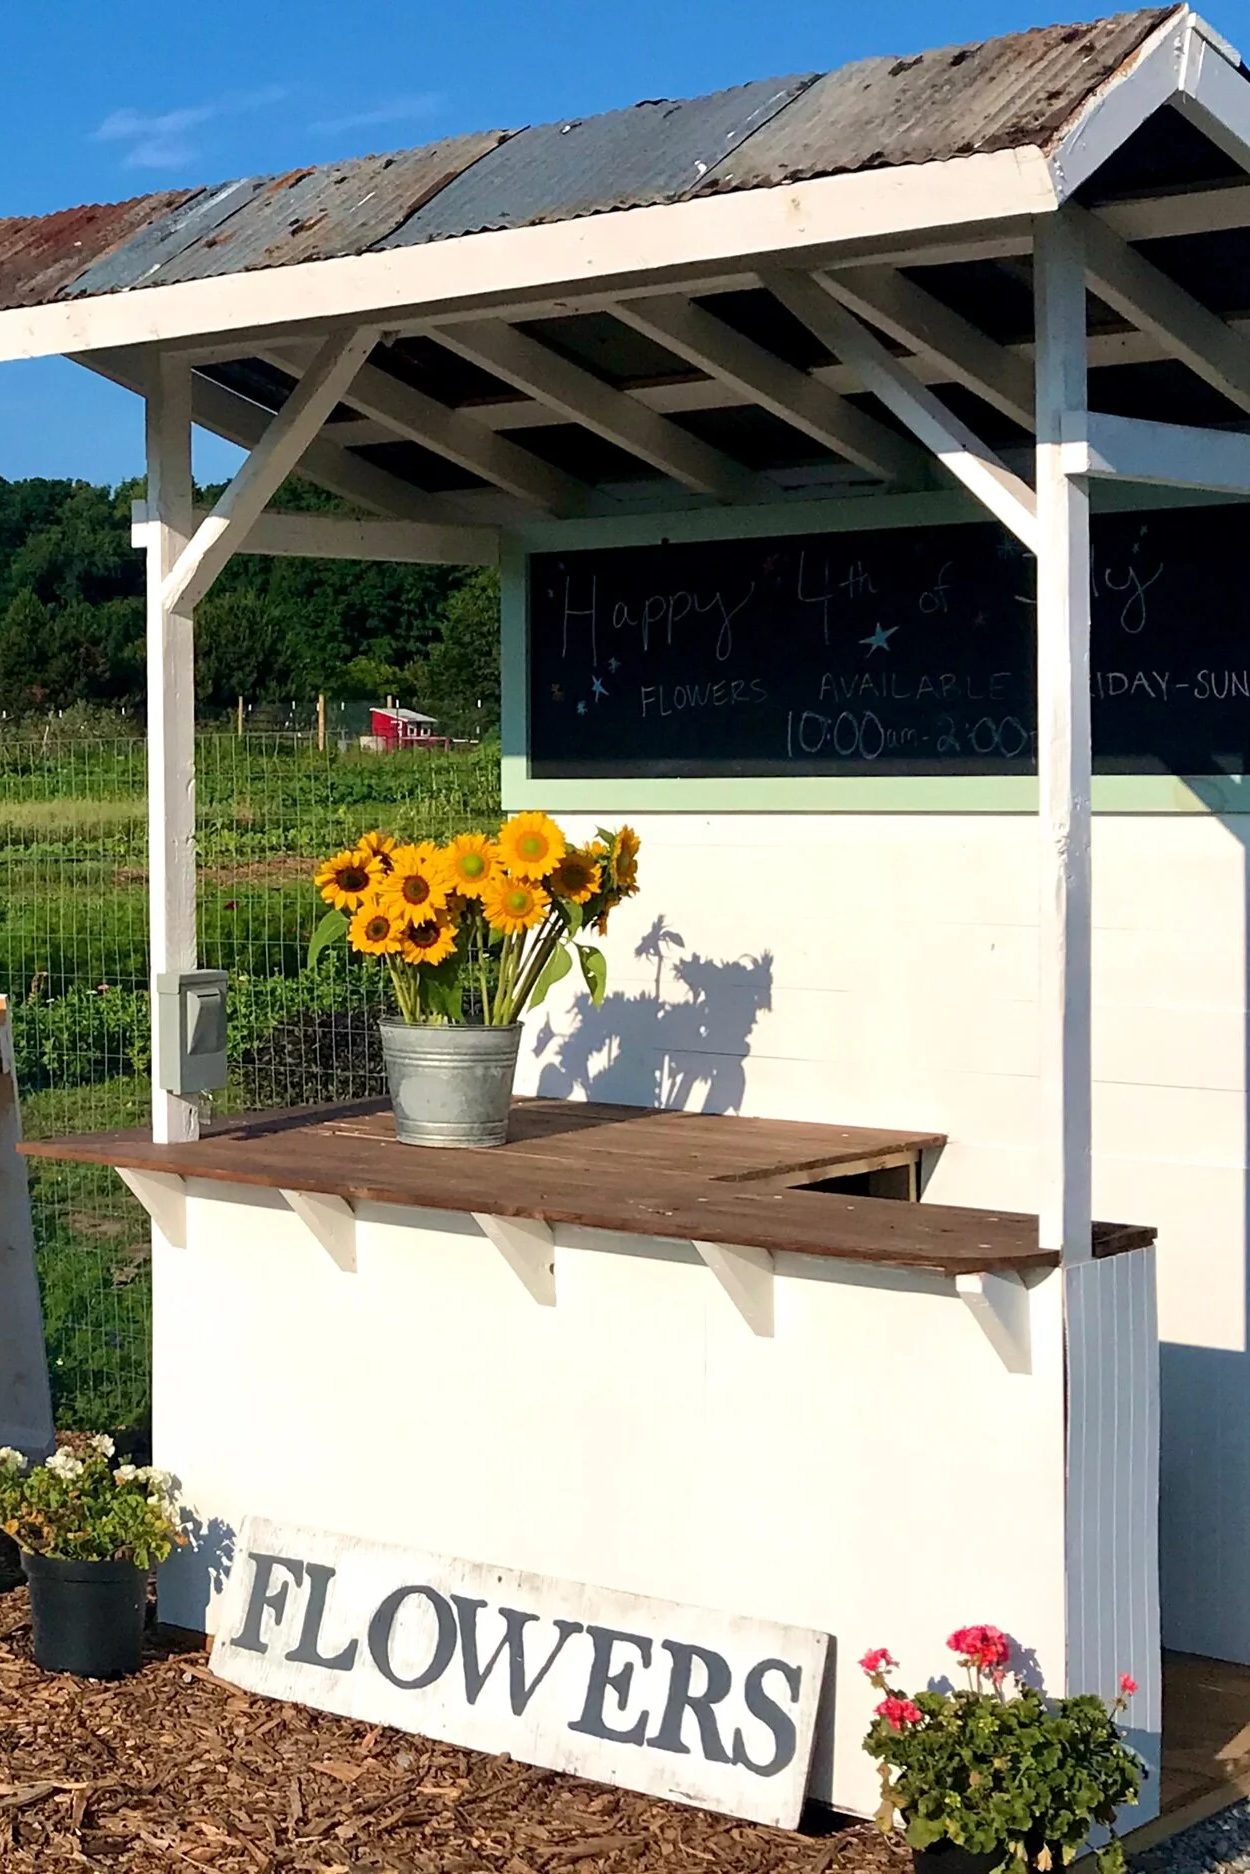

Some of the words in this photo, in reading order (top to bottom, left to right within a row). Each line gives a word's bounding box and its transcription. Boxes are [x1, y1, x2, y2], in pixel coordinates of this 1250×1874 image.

[562, 574, 756, 667] Happy
[797, 550, 879, 646] 4th
[918, 560, 954, 615] of
[641, 678, 769, 718] FLOWERS
[818, 671, 1012, 703] AVAILABLE
[1089, 668, 1250, 701] IDAY-SUN
[230, 1551, 803, 1778] FLOWERS
